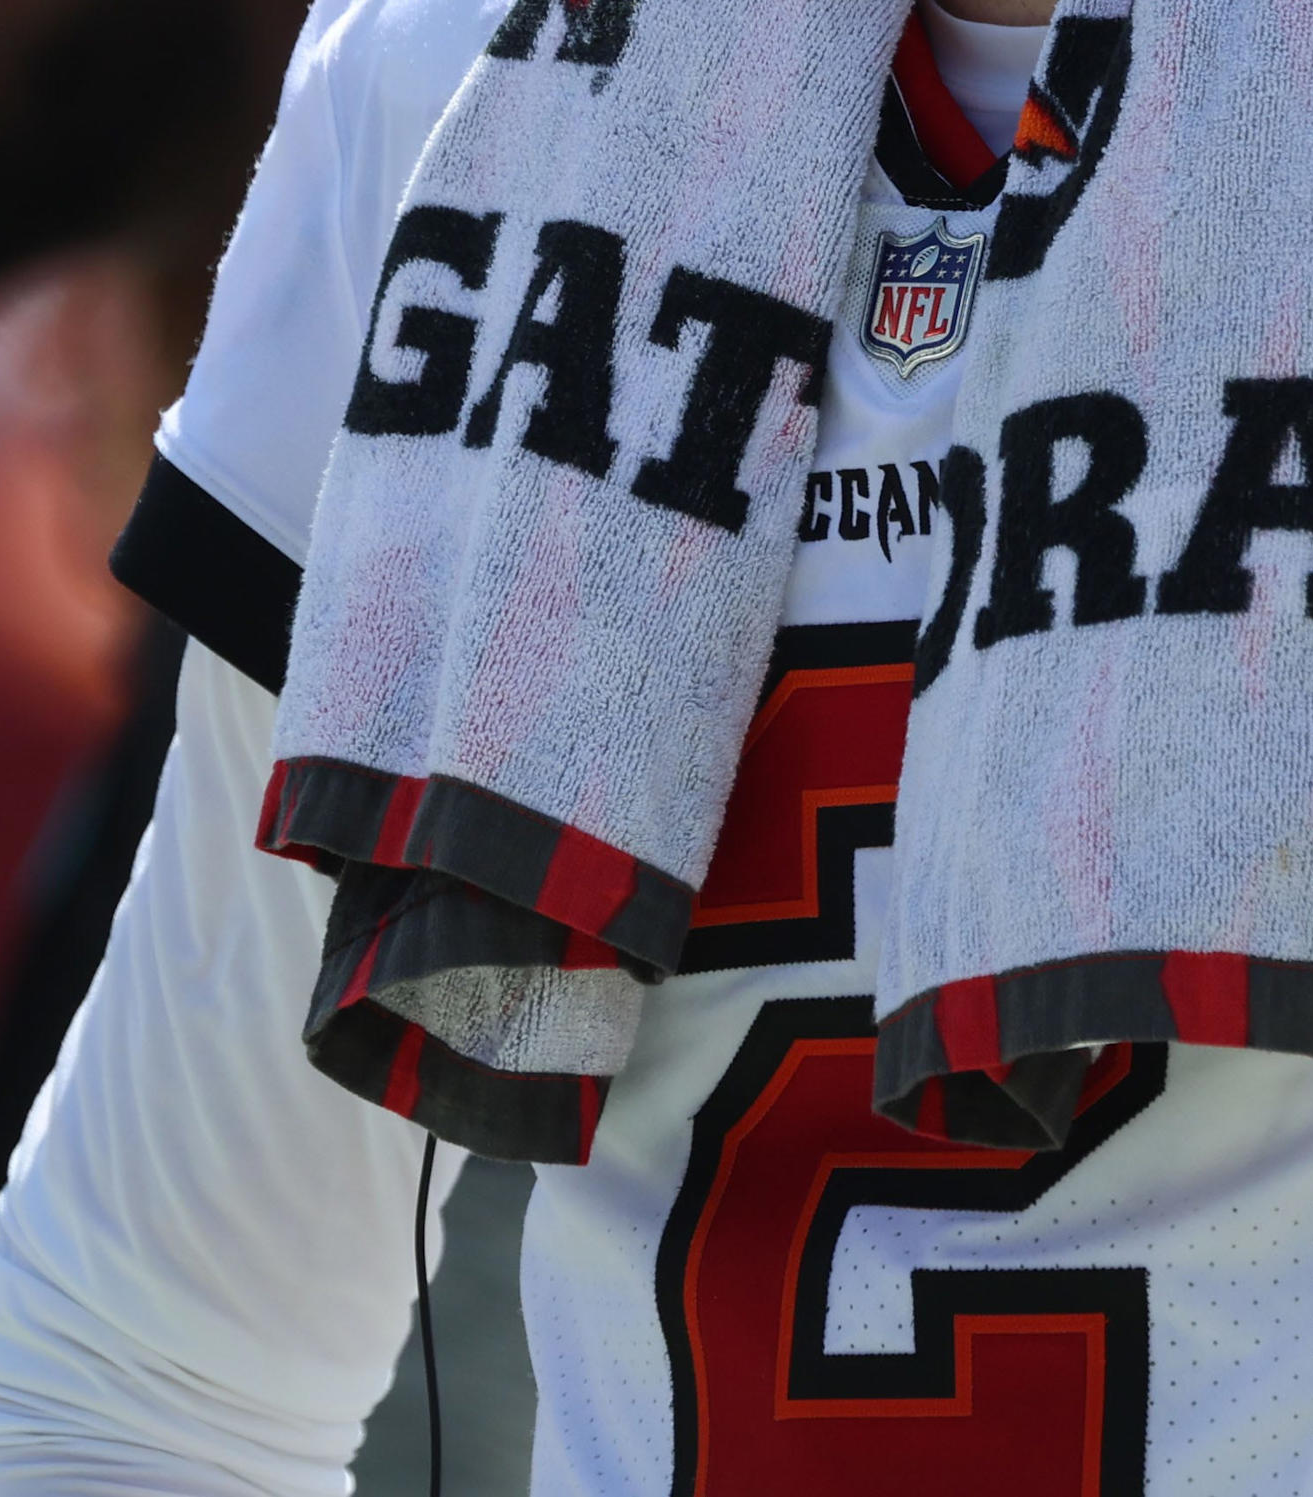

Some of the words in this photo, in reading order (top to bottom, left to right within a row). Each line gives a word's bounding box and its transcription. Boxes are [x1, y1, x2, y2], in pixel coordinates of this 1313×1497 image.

[343, 204, 833, 535] GAT
[875, 286, 947, 345] NFL
[654, 620, 1170, 1497] 2
